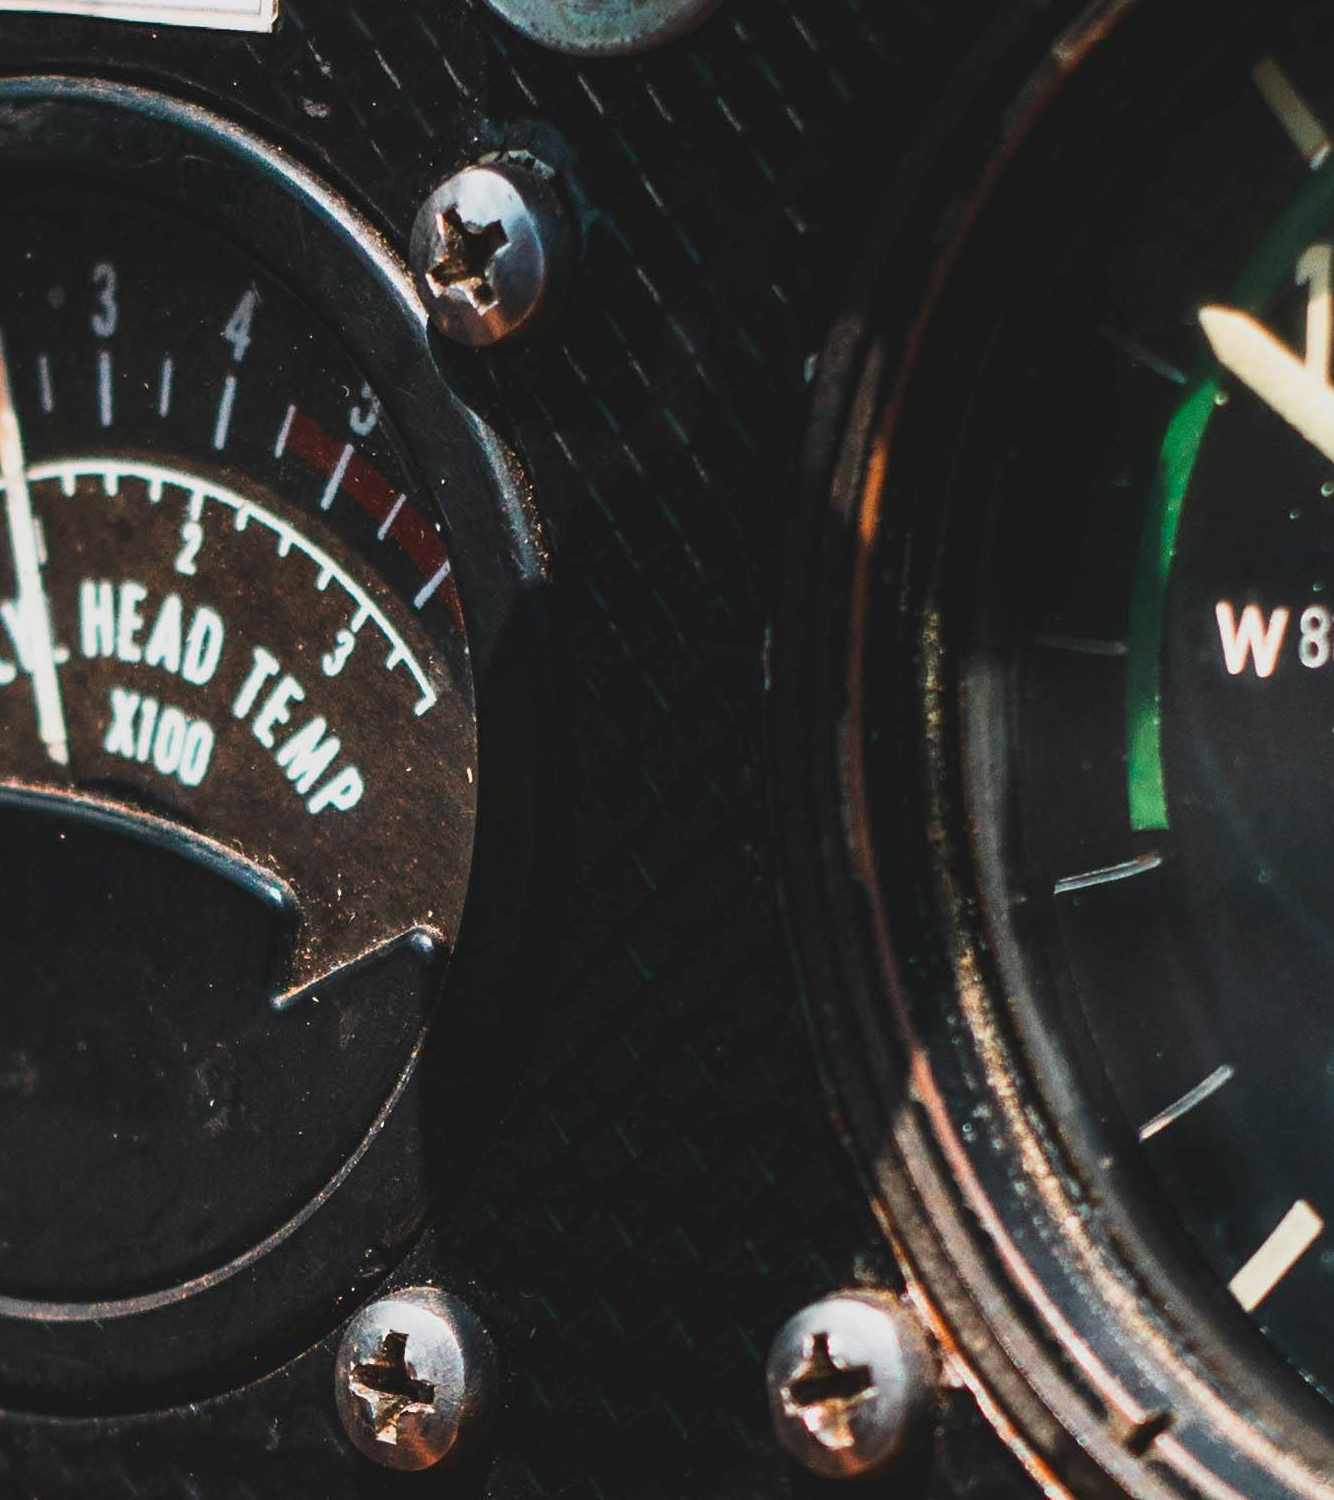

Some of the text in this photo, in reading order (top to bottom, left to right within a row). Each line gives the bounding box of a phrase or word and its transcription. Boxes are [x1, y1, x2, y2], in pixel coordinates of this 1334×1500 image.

[91, 262, 118, 338] 3
[223, 288, 255, 360] 4
[173, 524, 203, 576] 2
[322, 629, 357, 677] 3
[1215, 600, 1290, 678] W
[78, 579, 224, 686] HEAD
[232, 644, 365, 815] TEMP
[104, 686, 214, 787] X100
